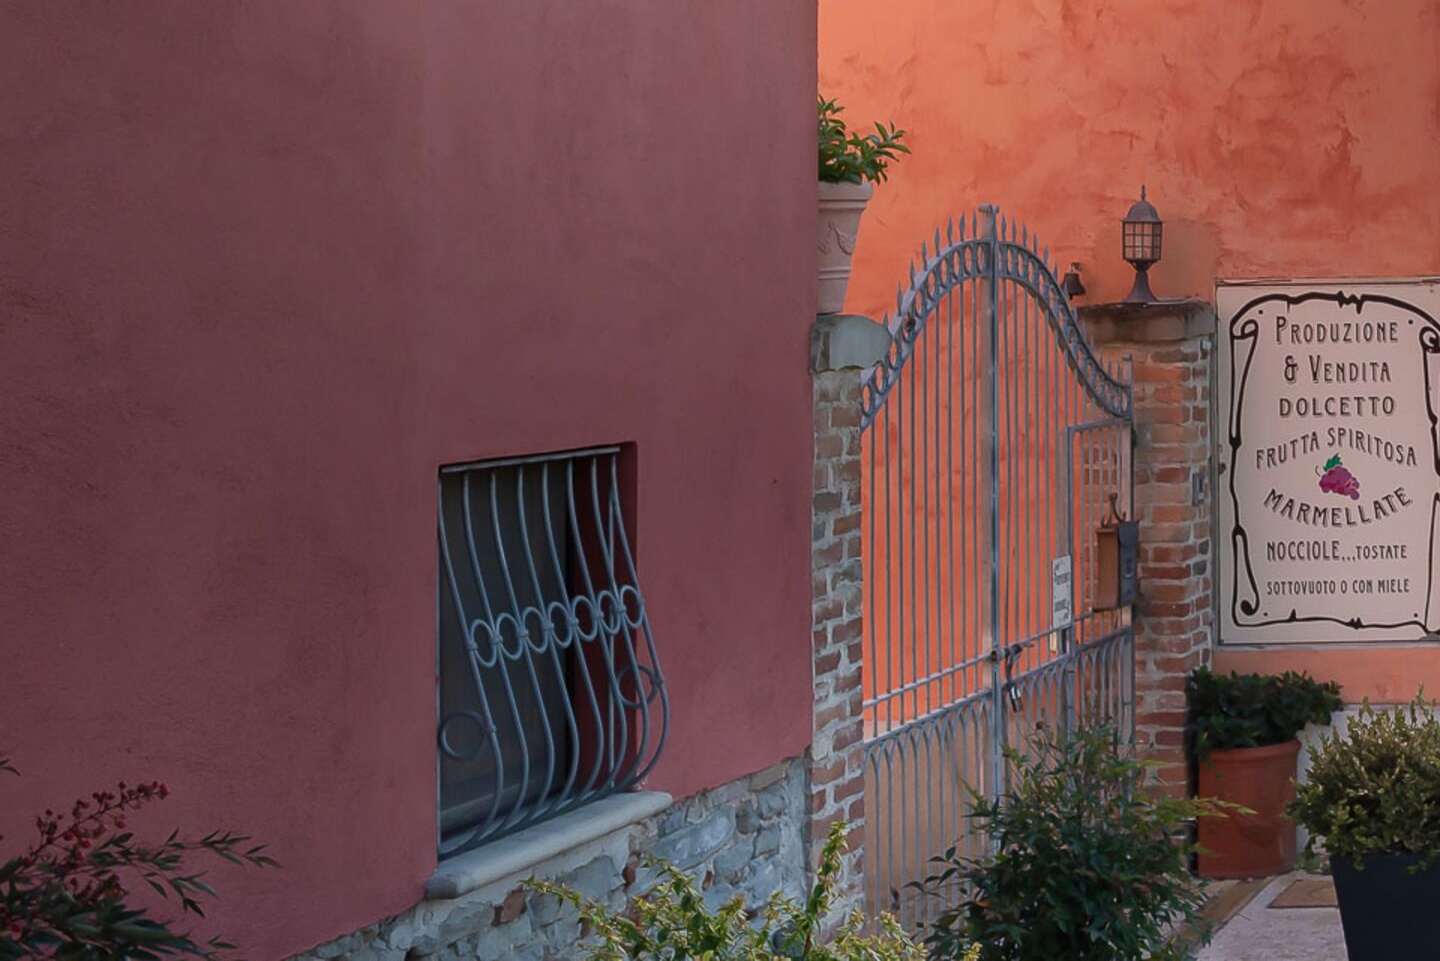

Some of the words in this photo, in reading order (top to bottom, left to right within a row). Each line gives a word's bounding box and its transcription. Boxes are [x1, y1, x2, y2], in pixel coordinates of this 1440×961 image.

[1275, 316, 1400, 344] PRODUZIONE
[1284, 355, 1298, 383] &
[1309, 355, 1392, 383] VENDITA
[1279, 396, 1395, 417] DOLCETTO
[1256, 431, 1320, 469] FRUTTA
[1327, 427, 1418, 467] SPIRITOSA
[1263, 487, 1413, 527] MARMELLATE
[1266, 580, 1336, 595] SOTTOVUOTO
[1340, 580, 1347, 594] O
[1352, 579, 1374, 594] CON
[1377, 578, 1410, 593] MIELE
